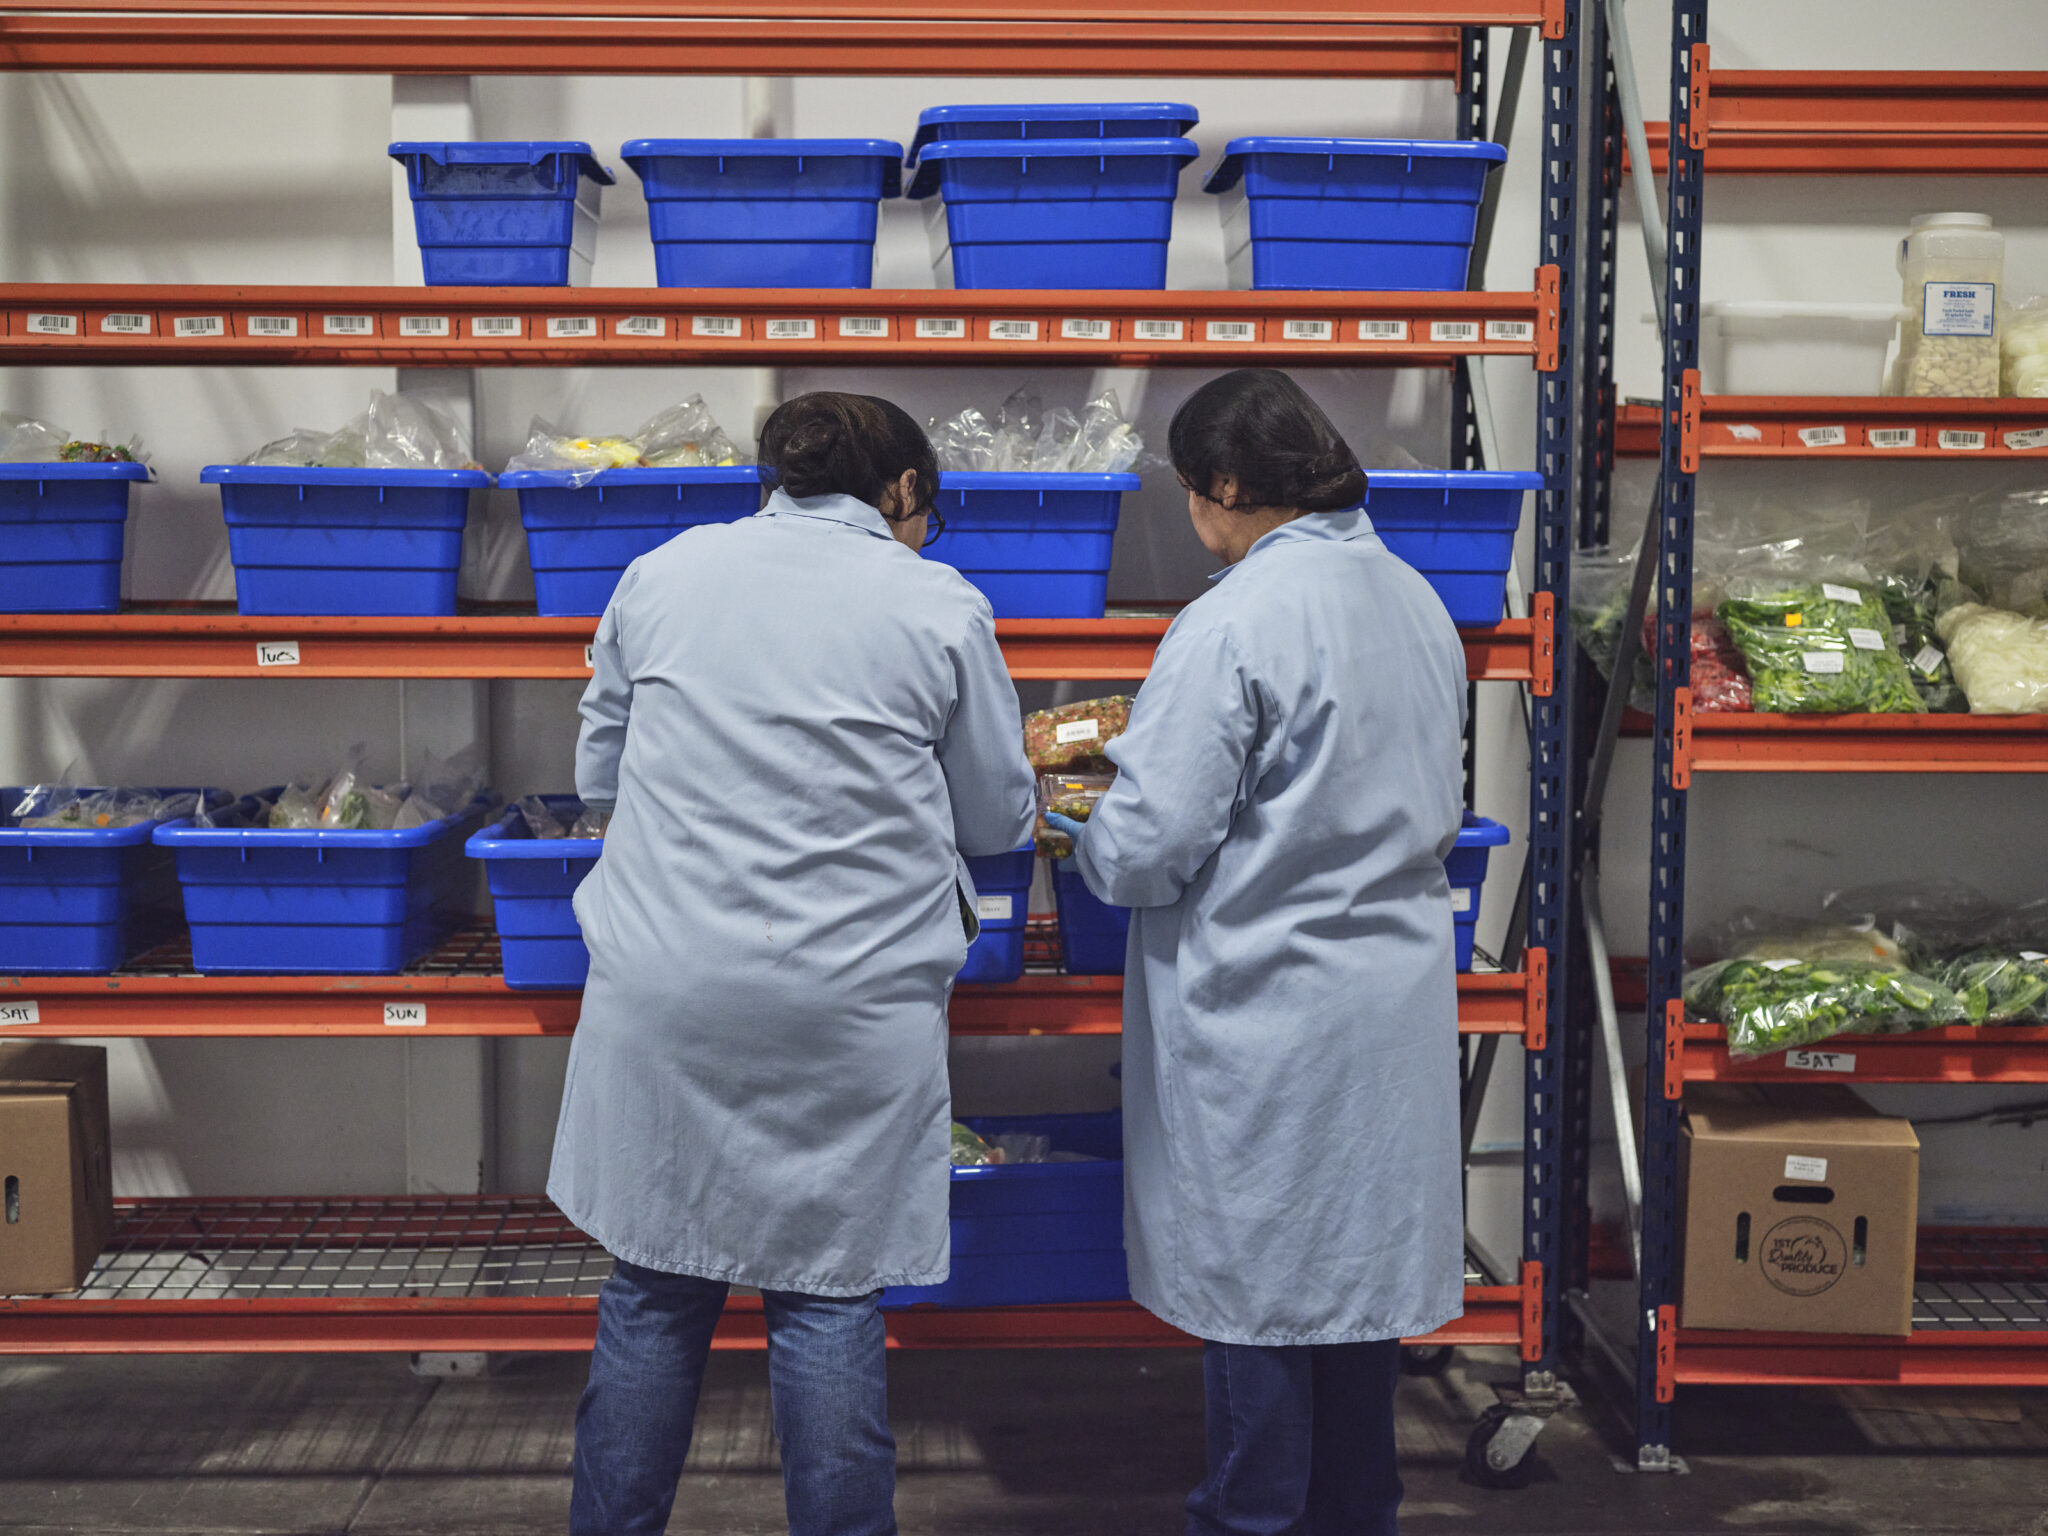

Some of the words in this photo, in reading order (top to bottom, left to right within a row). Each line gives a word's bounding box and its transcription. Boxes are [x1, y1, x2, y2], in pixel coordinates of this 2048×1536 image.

[1943, 290, 1976, 299] FRESH
[1, 1007, 29, 1020] SAT
[386, 1006, 417, 1020] SUN
[1795, 1051, 1839, 1068] SAT
[1781, 1263, 1837, 1274] PRODUCE
